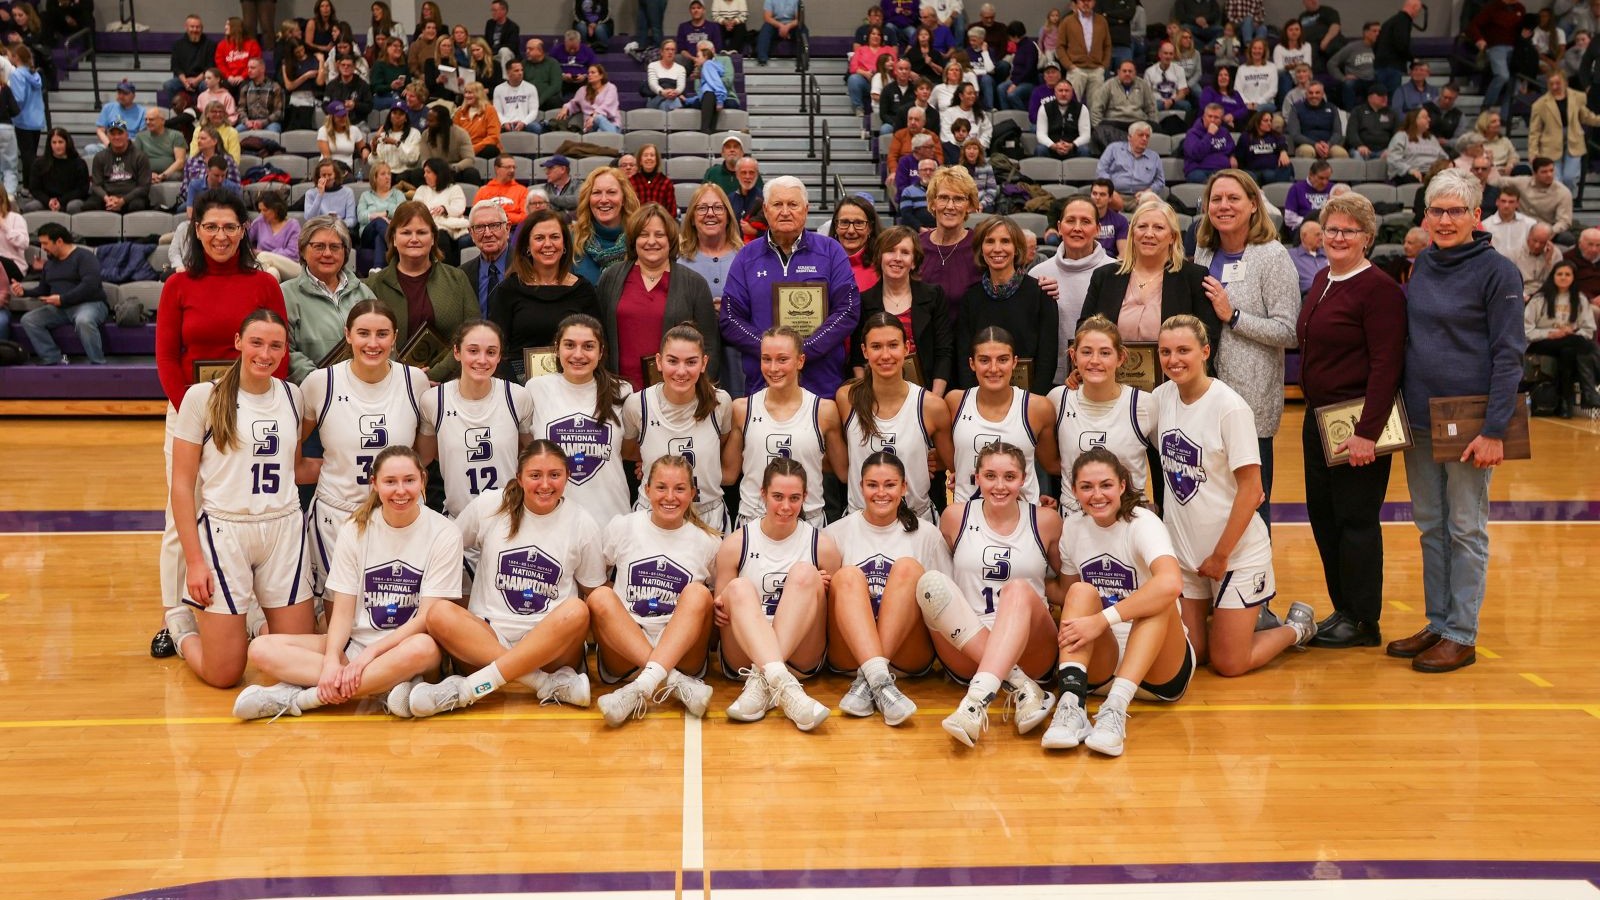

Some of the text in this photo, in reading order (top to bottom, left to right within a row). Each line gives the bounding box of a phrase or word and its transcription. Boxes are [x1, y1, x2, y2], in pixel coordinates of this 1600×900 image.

[252, 420, 280, 456] S
[359, 414, 388, 449] S
[465, 427, 493, 462] S
[251, 463, 280, 494] 15
[466, 466, 498, 495] 12
[512, 568, 545, 580] NATIONAL
[983, 546, 1011, 581] S
[378, 584, 412, 592] NATIONAL
[495, 572, 559, 600] CHAMPIONS
[642, 578, 674, 589] NATIONAL
[1092, 578, 1123, 586] NATIONAL
